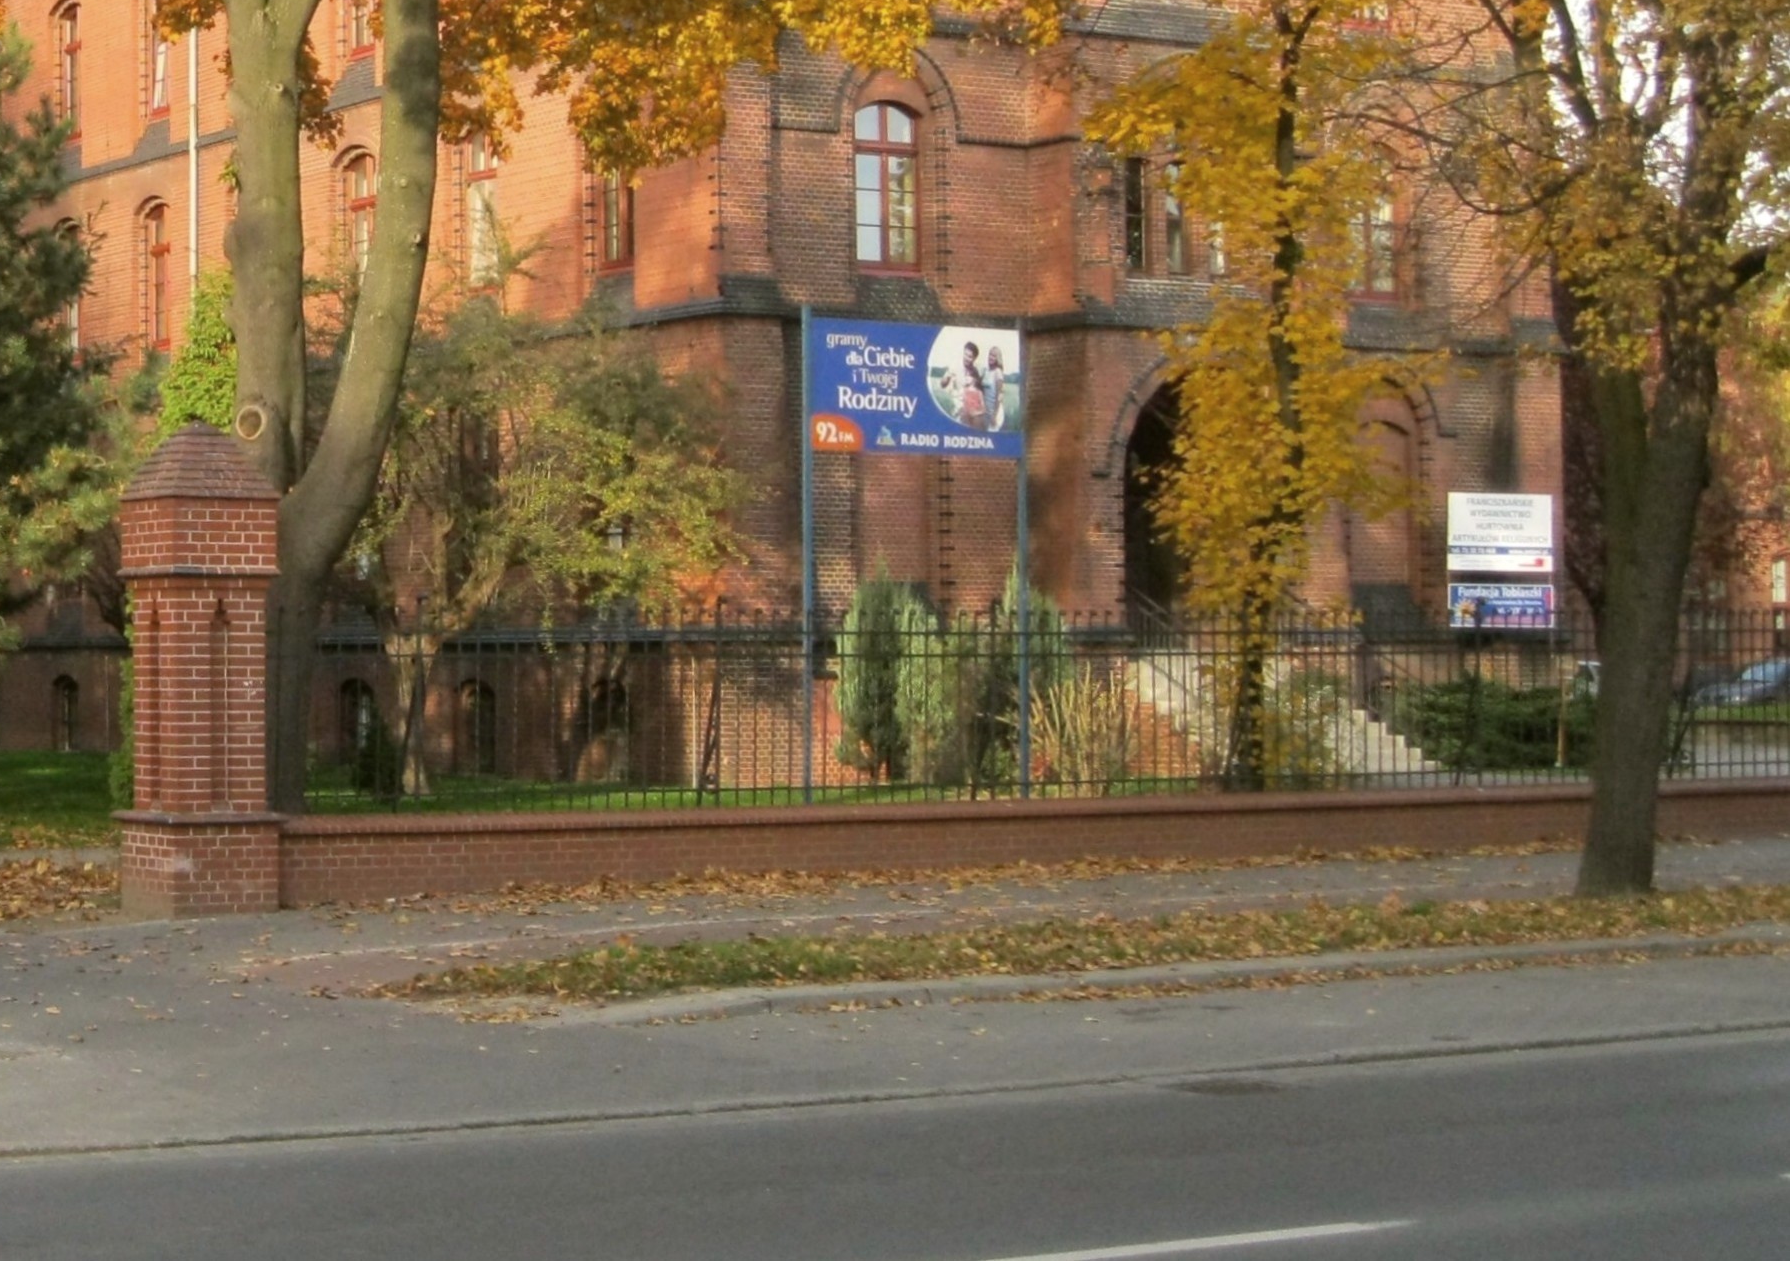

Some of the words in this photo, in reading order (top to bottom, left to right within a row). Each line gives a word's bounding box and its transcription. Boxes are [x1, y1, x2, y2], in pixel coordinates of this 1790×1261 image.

[826, 333, 867, 350] gramy
[845, 350, 863, 366] dla
[864, 346, 915, 369] Ciebie
[852, 369, 857, 384] i
[859, 368, 898, 389] Twojej
[837, 385, 918, 419] Rodziny
[816, 422, 838, 443] 92
[839, 432, 854, 443] FM
[901, 433, 939, 447] RADIO
[944, 436, 994, 449] RODZINA
[1470, 509, 1531, 519] WYDAWNICTWO
[1475, 522, 1524, 531] HURTOWNIA
[1458, 586, 1499, 598] Fundacja
[1501, 586, 1542, 597] Tobiaszki
